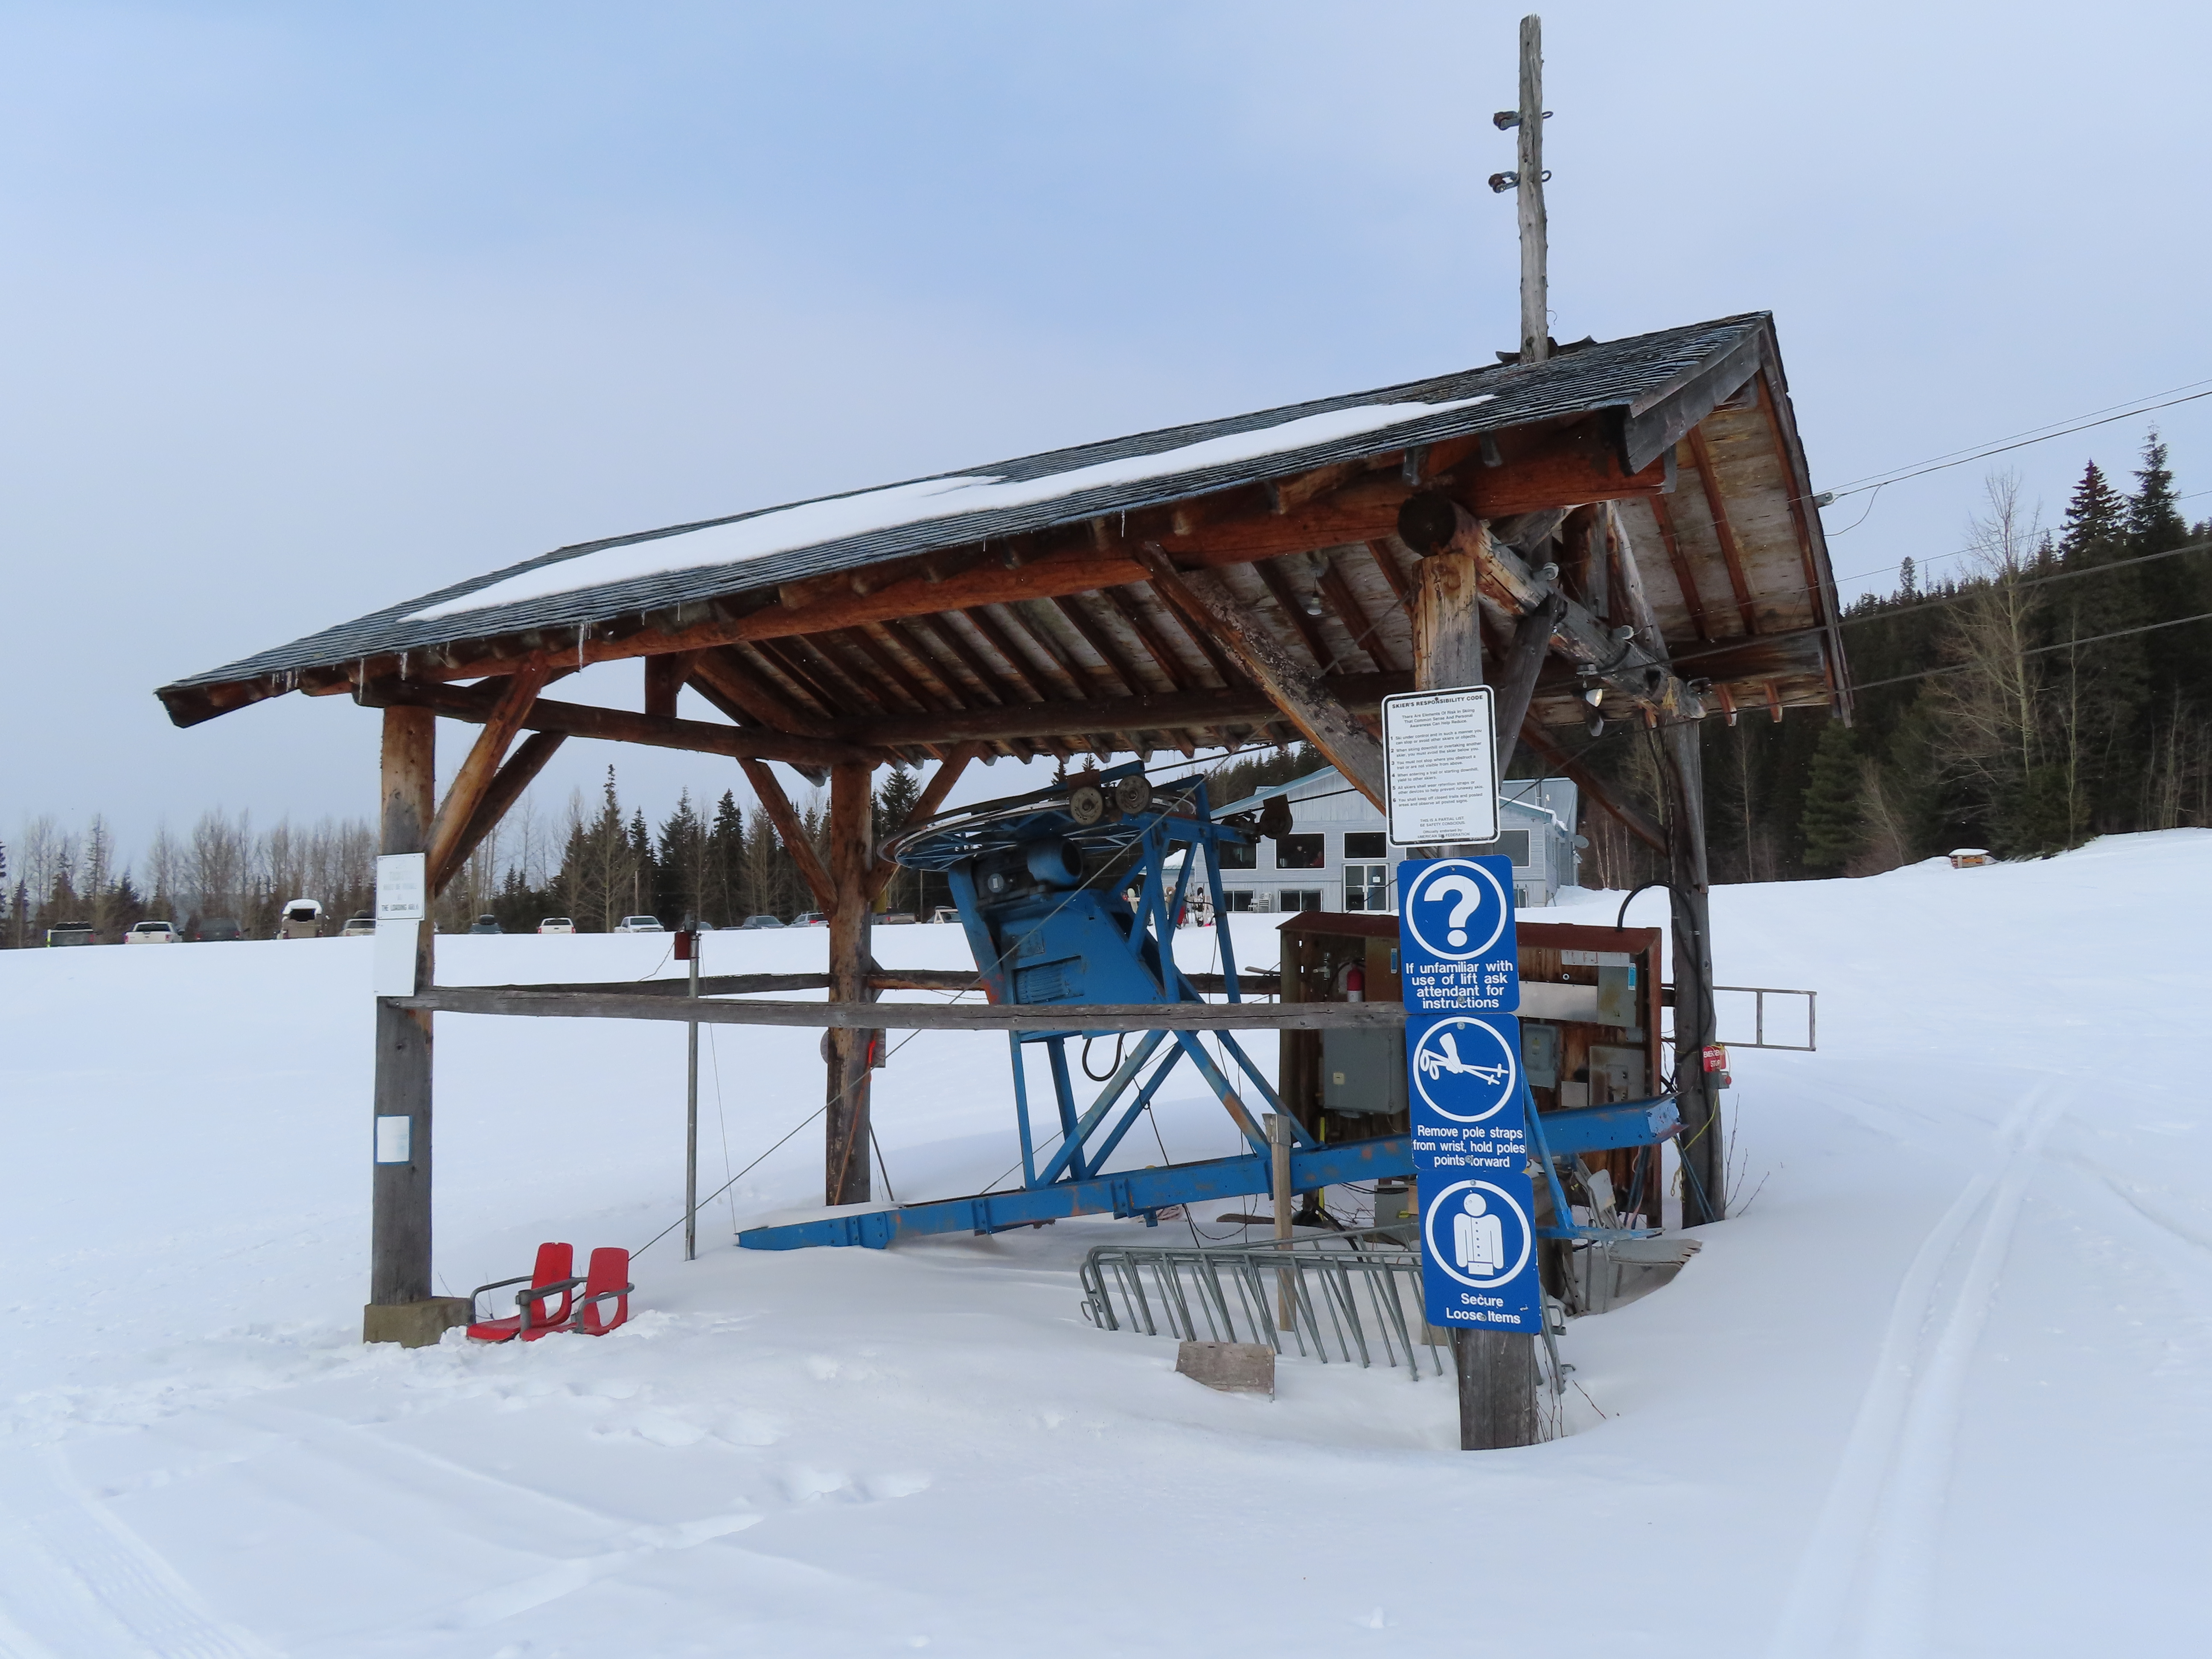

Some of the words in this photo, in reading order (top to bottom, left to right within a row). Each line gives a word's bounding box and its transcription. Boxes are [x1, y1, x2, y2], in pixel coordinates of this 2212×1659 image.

[1416, 697, 1465, 706] RESPONSIBILITY
[1406, 963, 1414, 974] If
[1420, 961, 1479, 974] unfamiliar
[1485, 960, 1513, 972] with
[1412, 976, 1435, 986] use
[1441, 973, 1454, 985] of
[1461, 973, 1477, 984] lift
[1484, 972, 1508, 984] ask
[1417, 985, 1480, 997] attendant
[1486, 985, 1504, 996] for
[1417, 1125, 1458, 1137] Remove
[1463, 1126, 1485, 1140] pole
[1490, 1126, 1523, 1141] straps
[1413, 1139, 1436, 1151] from
[1440, 1141, 1467, 1153] wrist,
[1470, 1141, 1493, 1153] hold
[1496, 1142, 1525, 1155] poles
[1434, 1154, 1465, 1167] points
[1461, 1293, 1504, 1307] Secure
[1446, 1307, 1487, 1321] Loose
[1487, 1310, 1521, 1324] Items
